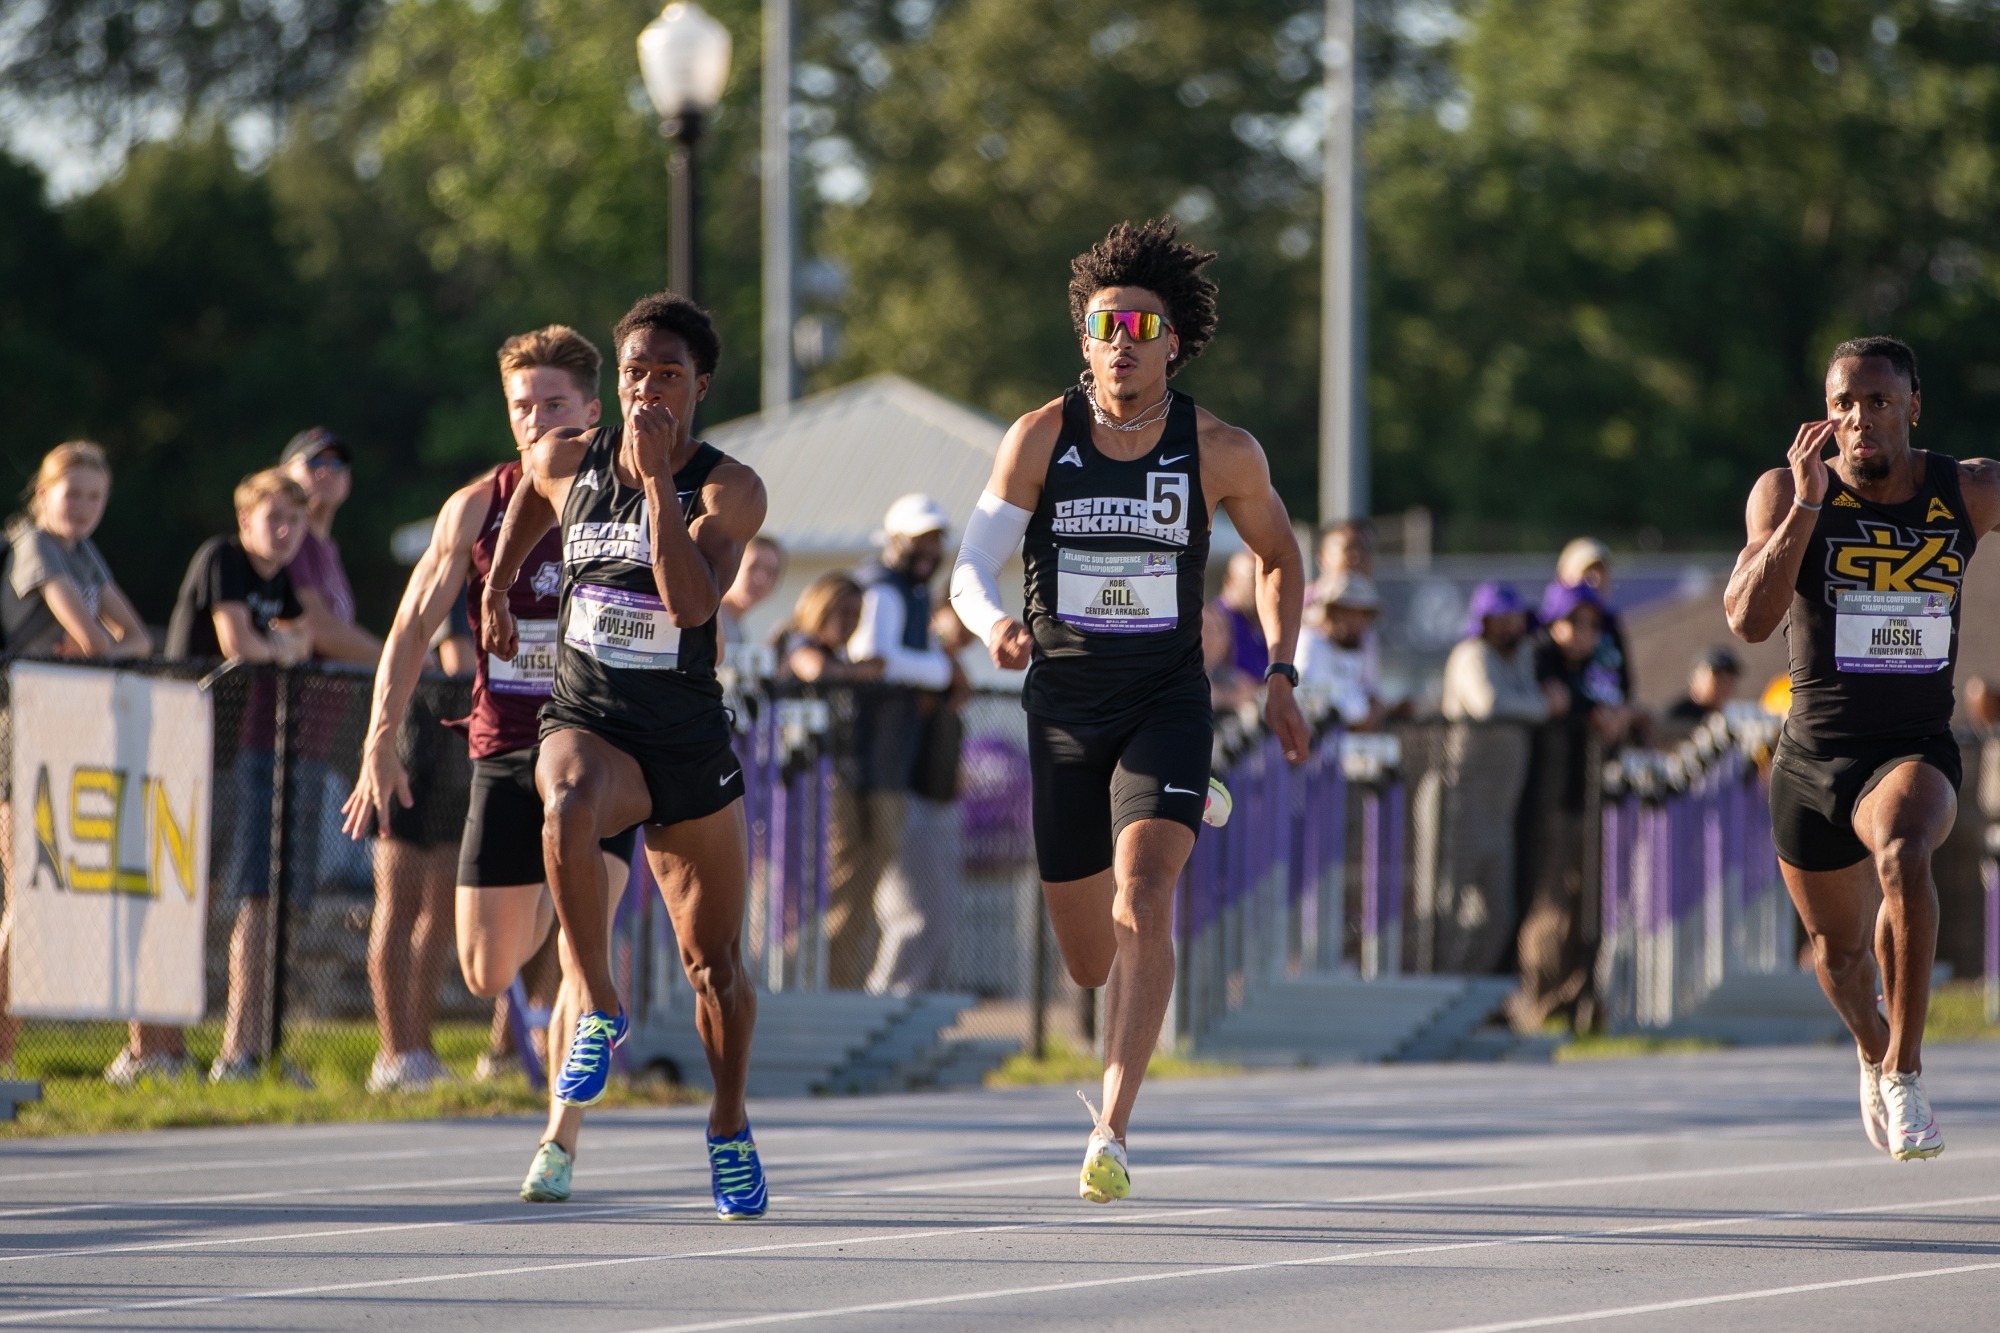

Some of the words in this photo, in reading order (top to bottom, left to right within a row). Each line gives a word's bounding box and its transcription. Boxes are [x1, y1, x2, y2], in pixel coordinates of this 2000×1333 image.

[1152, 476, 1182, 525] 5
[1831, 500, 1862, 509] adidas
[1055, 497, 1148, 518] CENTR
[567, 522, 641, 544] CENTR
[1064, 553, 1091, 562] ATLANTIC
[1091, 555, 1104, 563] SUN
[1105, 555, 1142, 563] CONFERENCE
[1080, 564, 1124, 573] CHAMPIONSHIP
[1109, 579, 1126, 587] KOBE
[1102, 589, 1134, 606] GILL
[1844, 594, 1872, 603] ATLANTIC
[1872, 595, 1885, 603] SUN
[1886, 595, 1922, 604] CONFERENCE
[1084, 606, 1114, 616] CENTRAL
[1114, 607, 1150, 616] ARKANSAS
[1861, 604, 1905, 613] CHAMPIONSHIP
[626, 609, 653, 621] CENTRAL
[1889, 619, 1907, 627] TYRIQ
[1871, 628, 1923, 646] HUSSIE
[1869, 647, 1904, 656] KENNESAW
[1905, 648, 1923, 656] STATE
[511, 654, 554, 670] HUTSL
